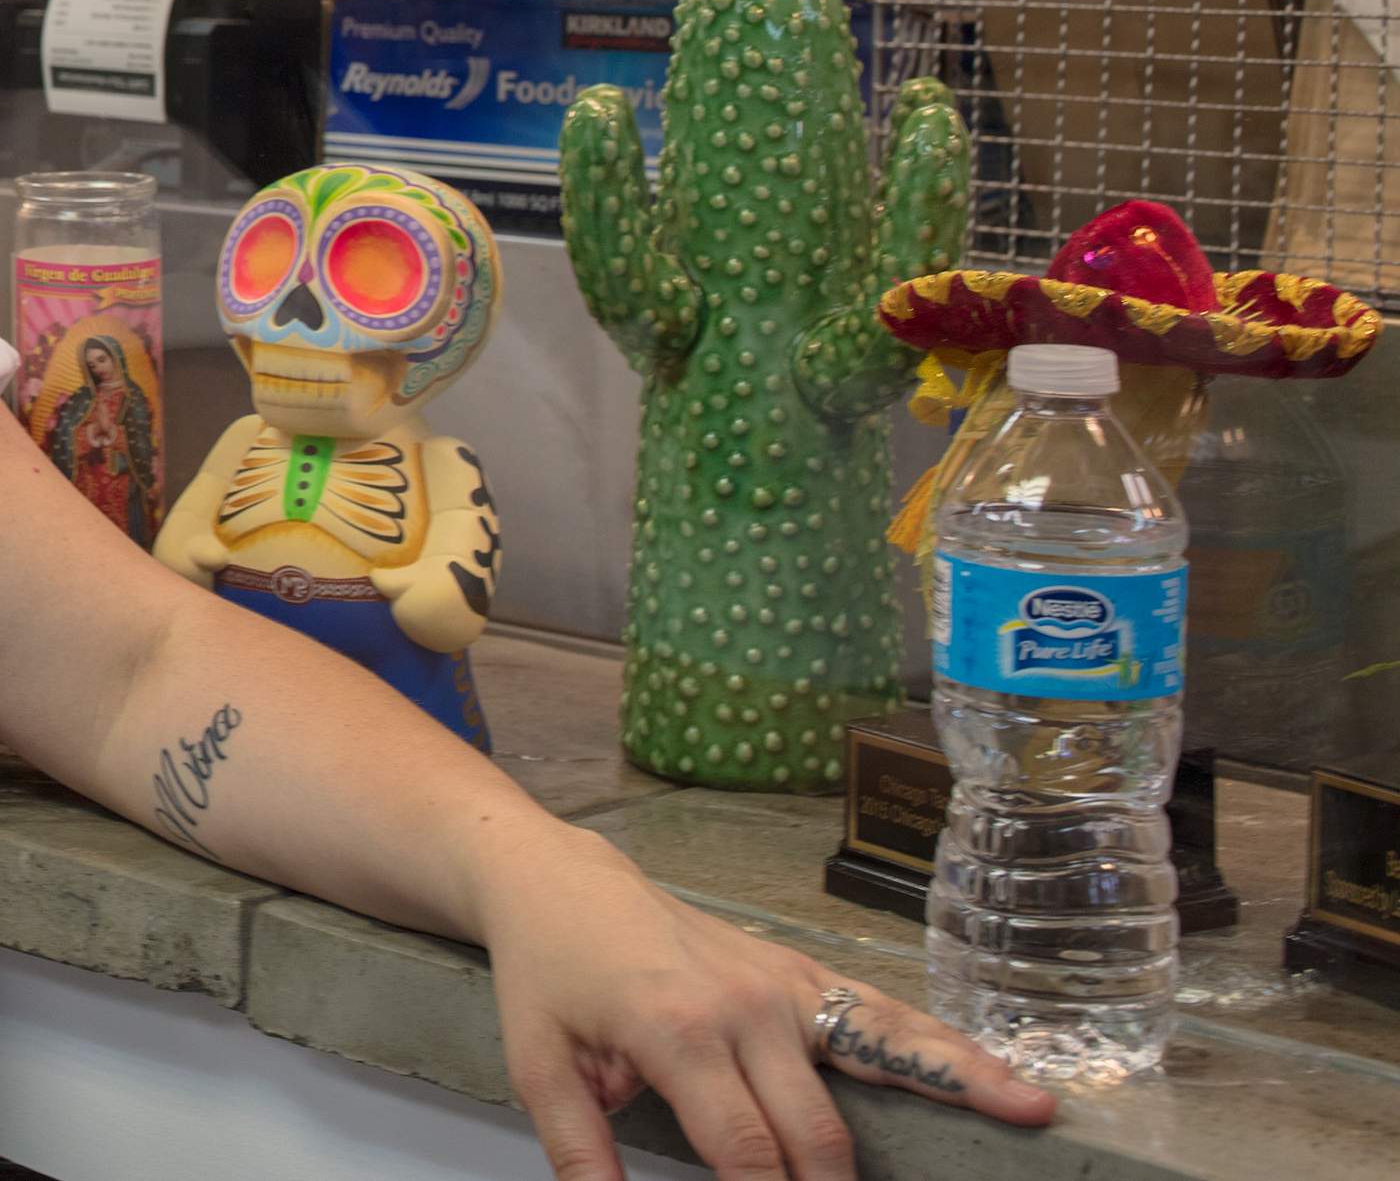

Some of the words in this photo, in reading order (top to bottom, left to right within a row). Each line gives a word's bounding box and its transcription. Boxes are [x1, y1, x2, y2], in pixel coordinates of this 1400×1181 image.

[341, 16, 417, 41] Premium
[420, 20, 485, 49] Quality
[566, 13, 672, 38] KIRKLAND
[341, 61, 460, 102] Reynolds
[1018, 639, 1070, 661] Pure
[1071, 638, 1114, 660] Life
